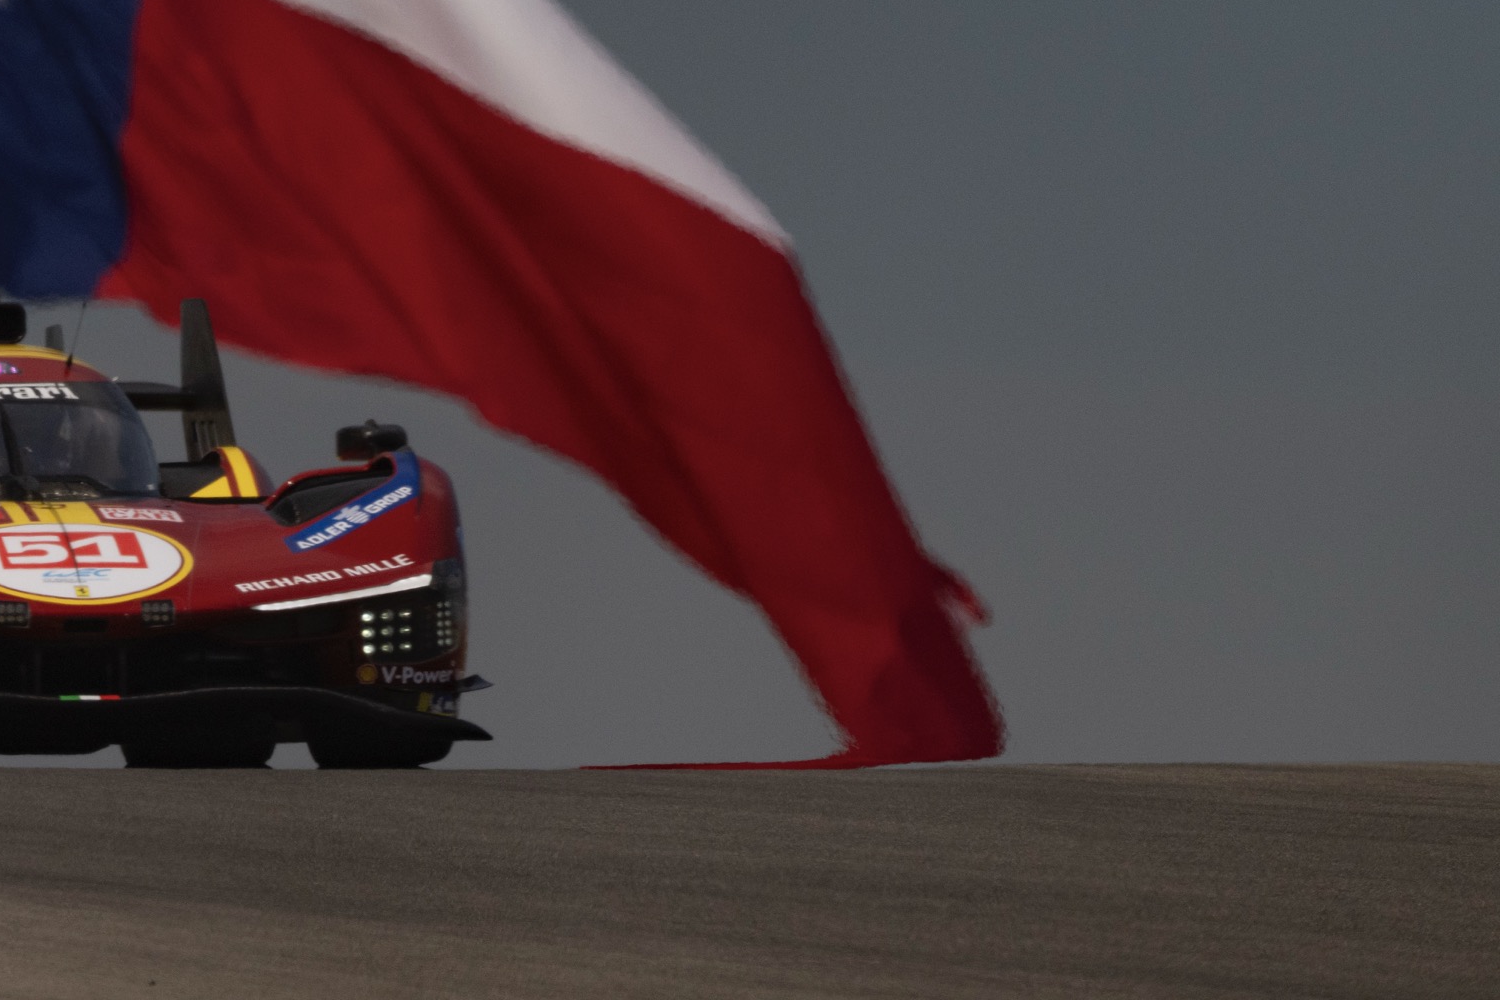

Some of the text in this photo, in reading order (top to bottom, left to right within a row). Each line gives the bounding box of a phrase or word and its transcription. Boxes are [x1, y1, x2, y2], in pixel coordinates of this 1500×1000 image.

[296, 486, 413, 550] ADLER GROUP
[0, 534, 140, 565] 51
[235, 553, 415, 593] RICHARD MILLE
[381, 666, 454, 684] V-Power
